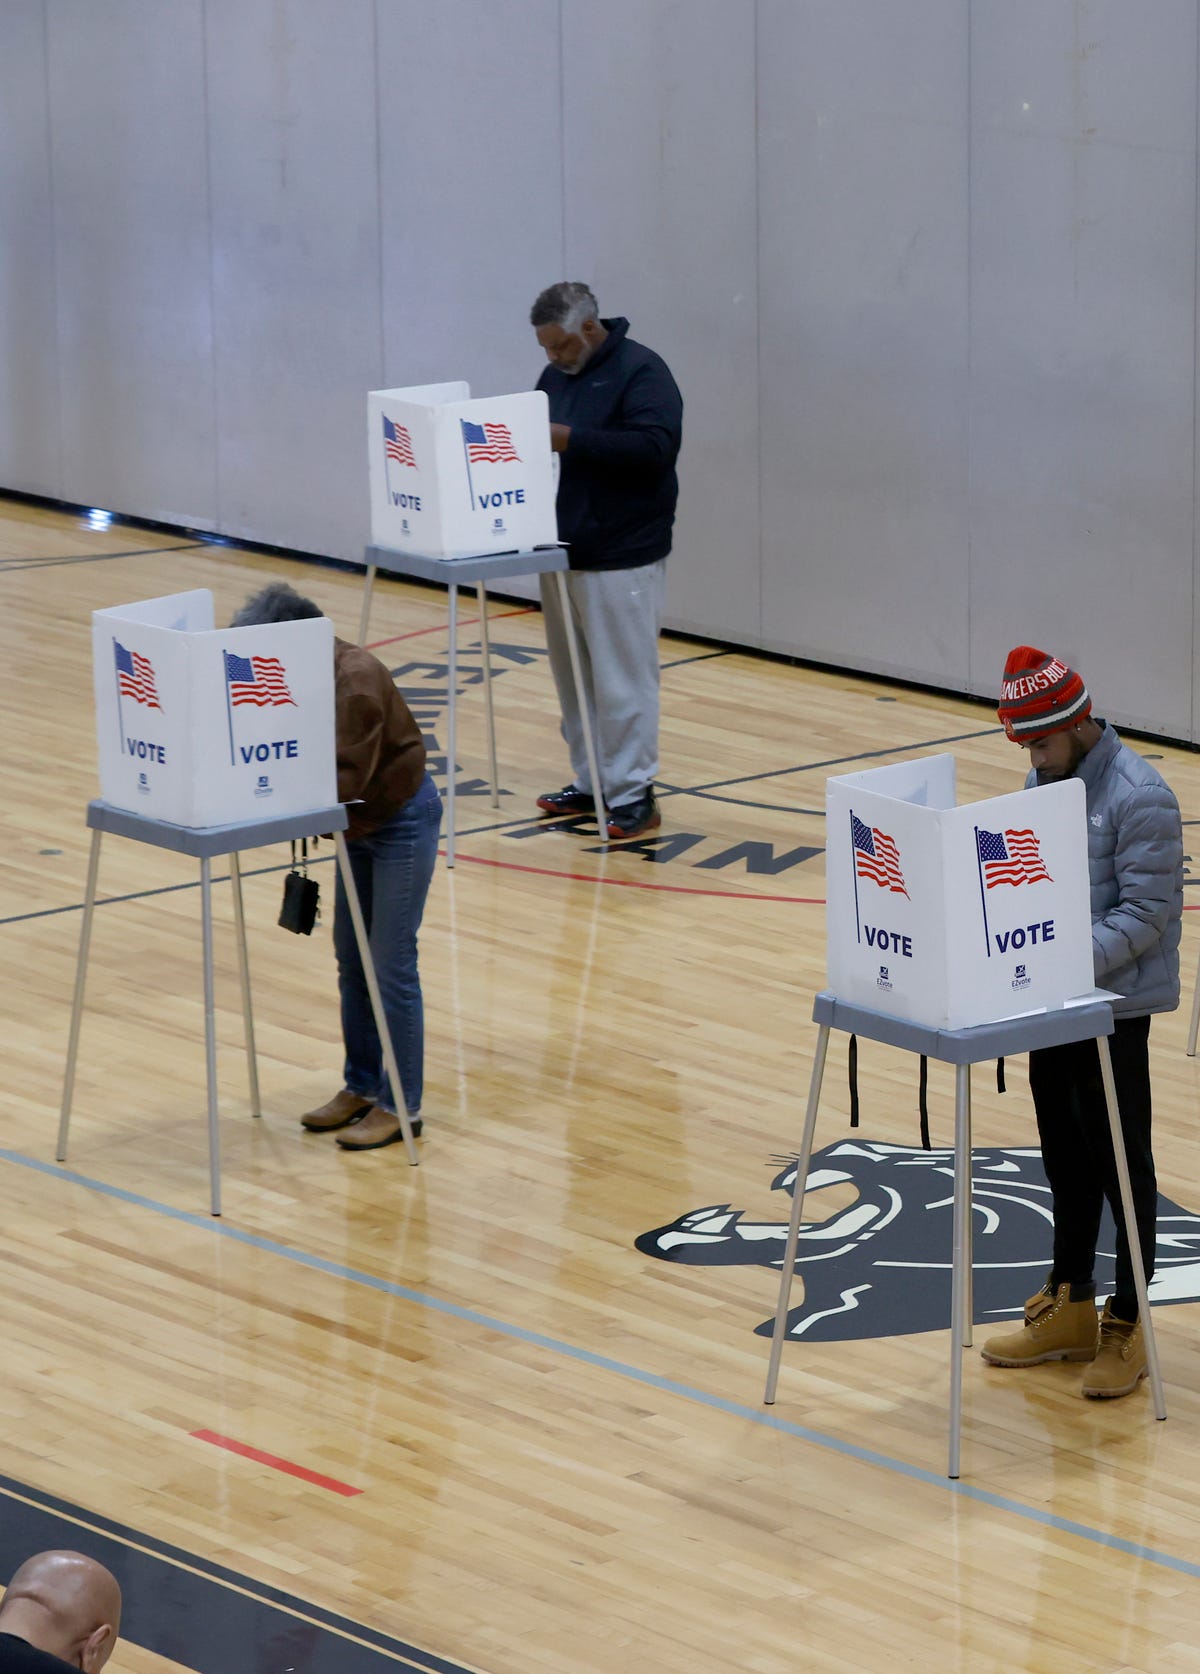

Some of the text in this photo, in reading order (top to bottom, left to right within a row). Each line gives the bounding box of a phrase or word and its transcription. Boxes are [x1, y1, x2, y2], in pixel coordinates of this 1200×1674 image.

[393, 493, 421, 511] VOTE
[479, 489, 525, 509] VOTE
[128, 738, 165, 764] VOTE
[241, 740, 297, 763] VOTE
[865, 926, 912, 957] VOTE
[996, 920, 1054, 953] VOTE
[876, 978, 894, 989] EZvote
[1012, 977, 1032, 988] EZvote
